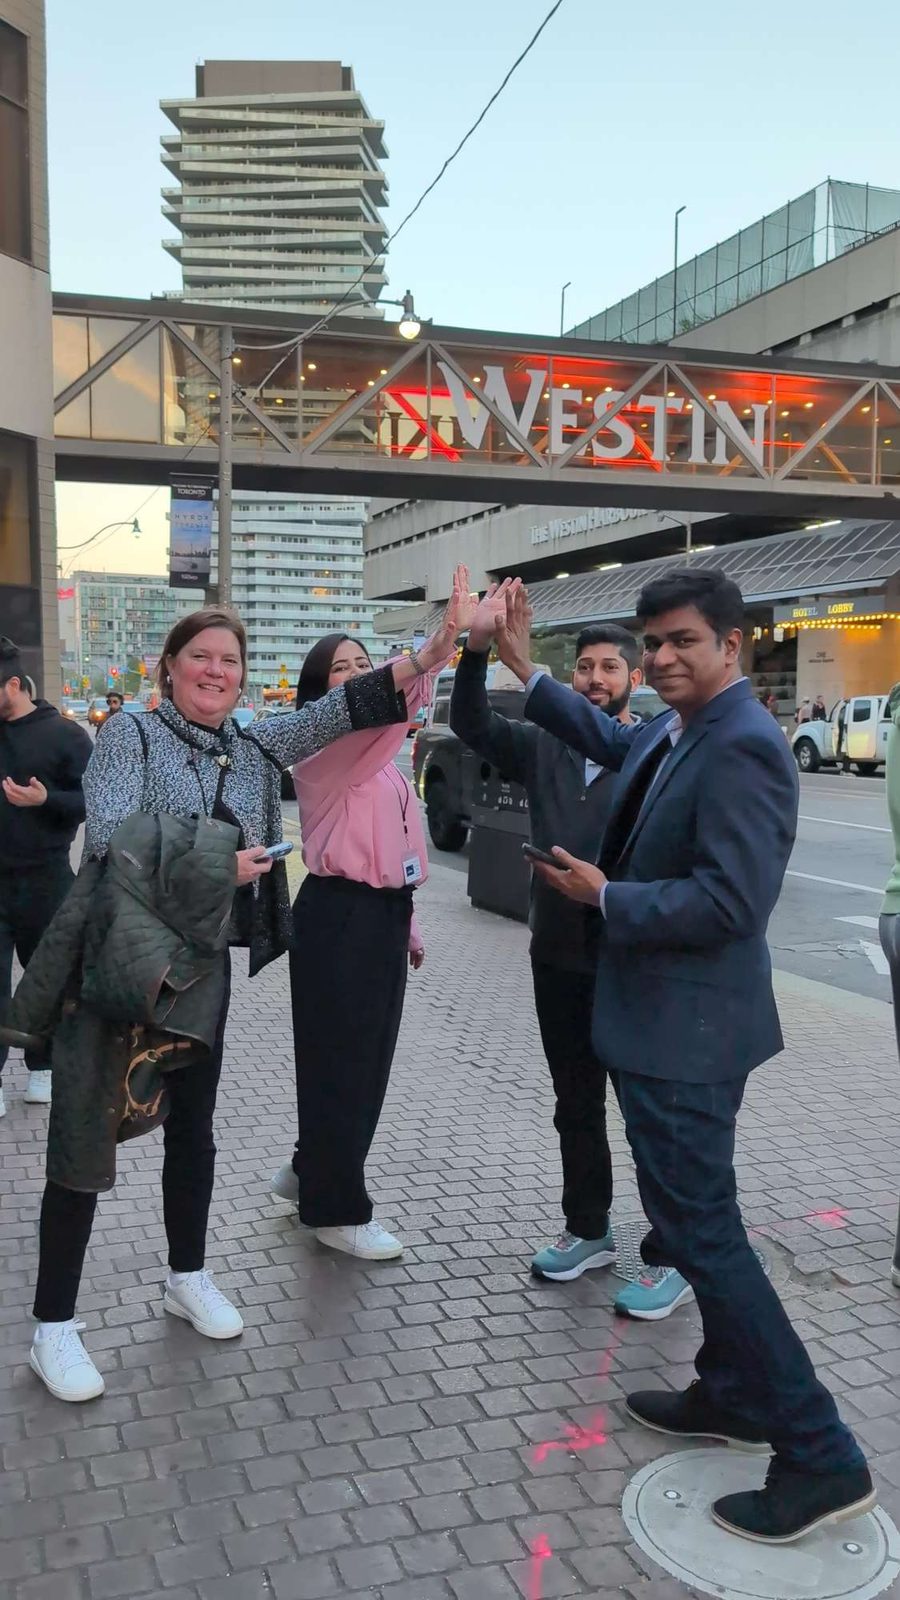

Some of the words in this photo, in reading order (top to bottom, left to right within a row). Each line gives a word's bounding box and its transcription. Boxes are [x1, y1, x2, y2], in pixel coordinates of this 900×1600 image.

[436, 361, 769, 467] WESTIN
[793, 606, 818, 617] HOTEL
[827, 603, 854, 614] LOBBY
